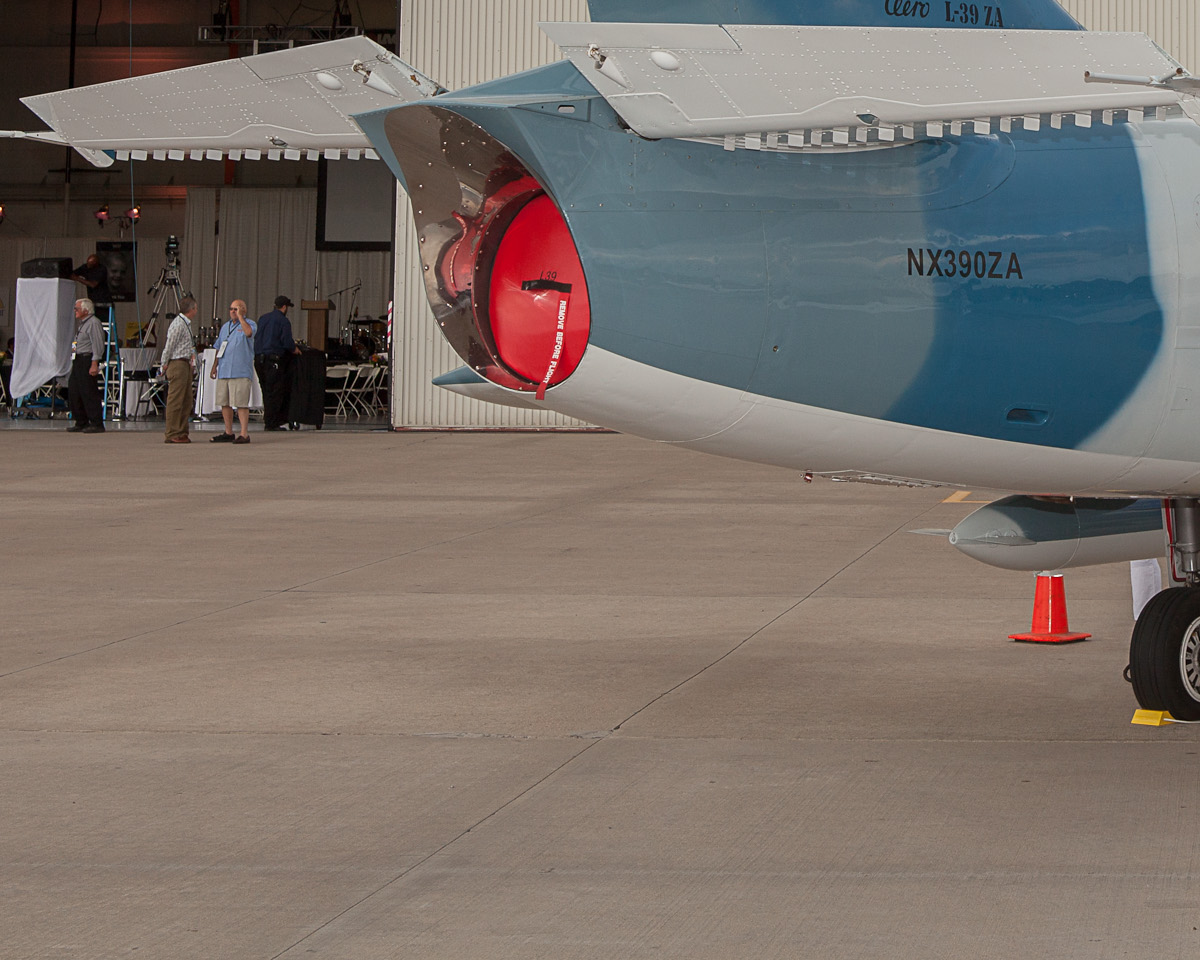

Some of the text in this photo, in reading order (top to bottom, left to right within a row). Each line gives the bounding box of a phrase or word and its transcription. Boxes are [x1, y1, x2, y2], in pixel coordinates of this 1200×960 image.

[944, 0, 1004, 28] L-39 ZA
[906, 247, 1024, 280] NX390ZA
[543, 300, 567, 383] REMOVE BEFORE FLIGHT
